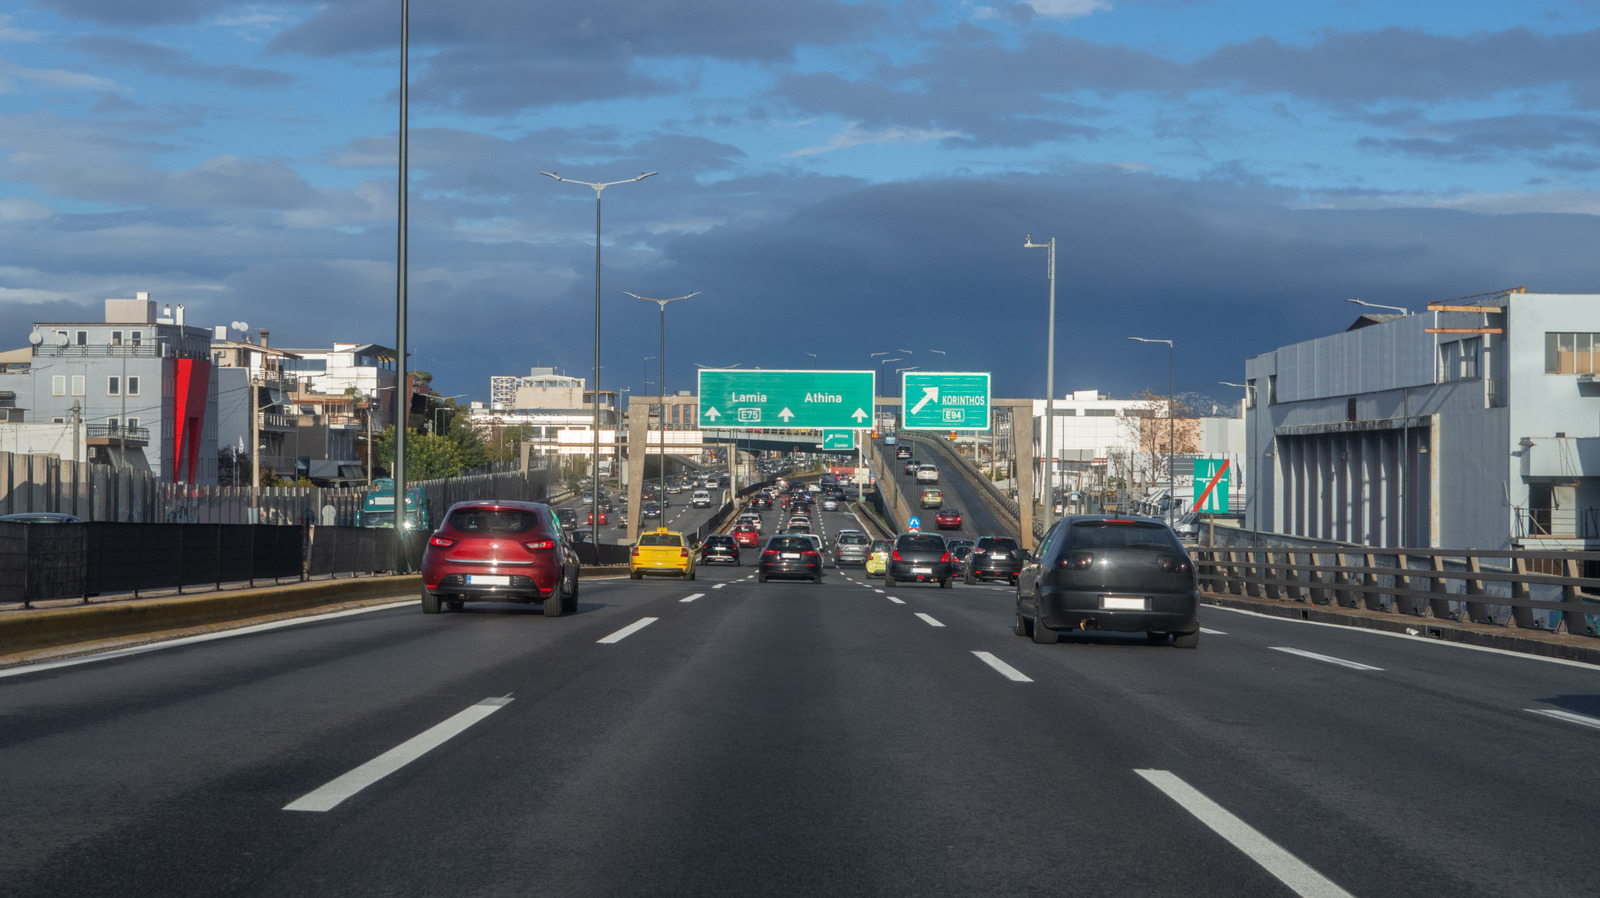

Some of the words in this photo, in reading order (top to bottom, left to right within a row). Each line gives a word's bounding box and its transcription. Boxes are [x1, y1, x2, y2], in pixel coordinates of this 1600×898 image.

[732, 392, 767, 403] Lamia
[804, 392, 842, 403] Athina
[942, 395, 985, 405] KORINTHOS
[741, 410, 759, 420] E75
[945, 411, 962, 420] E94
